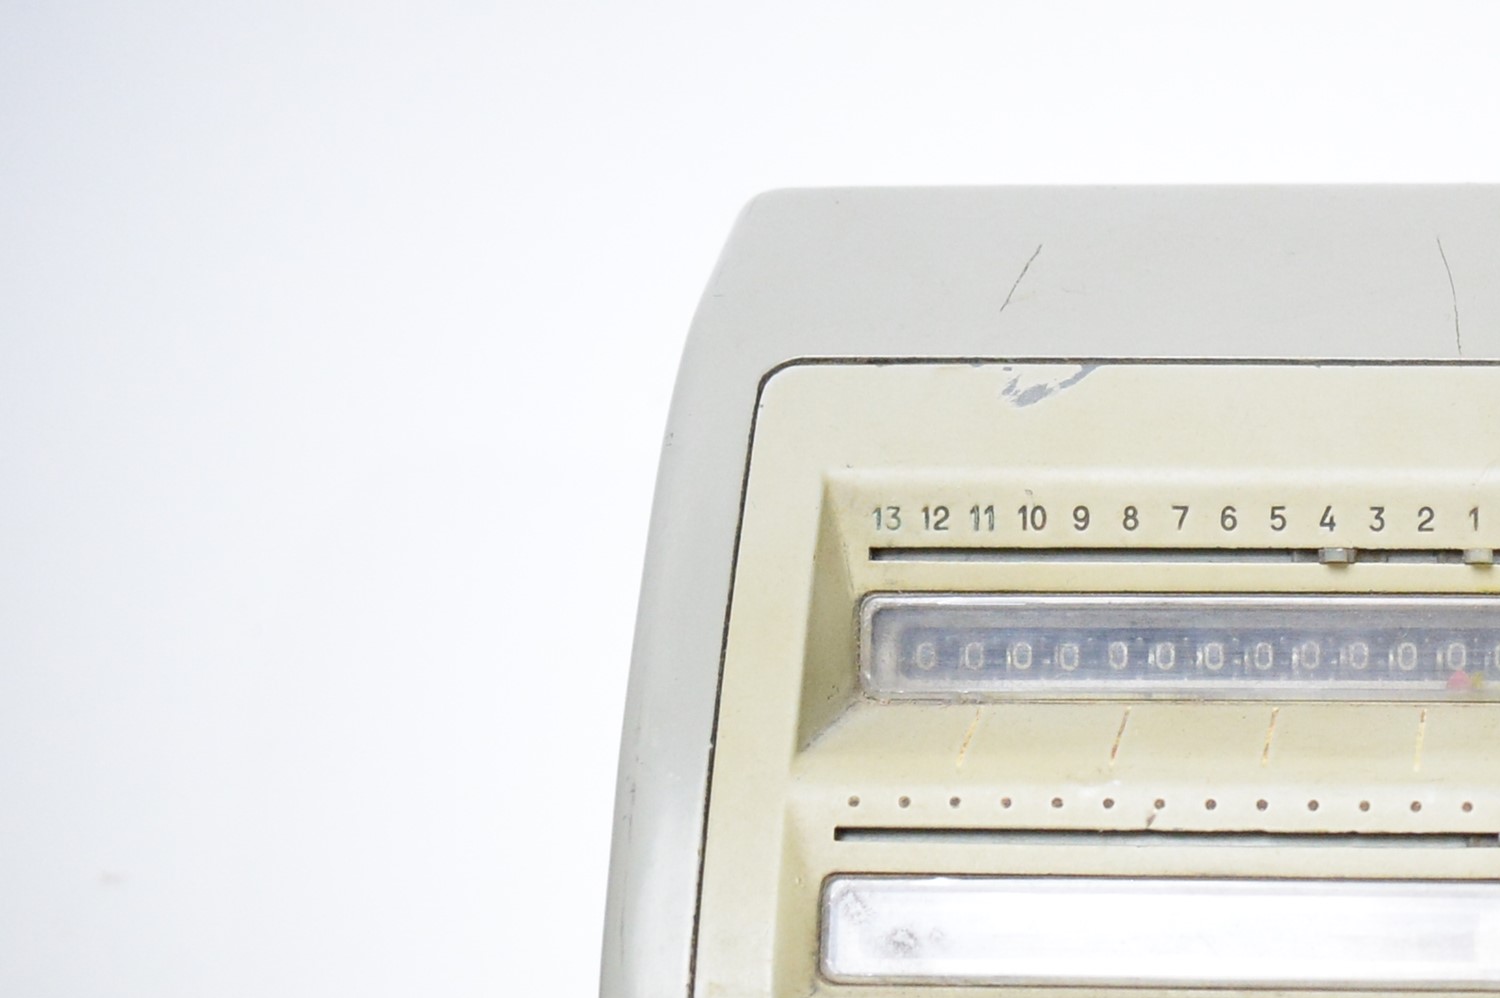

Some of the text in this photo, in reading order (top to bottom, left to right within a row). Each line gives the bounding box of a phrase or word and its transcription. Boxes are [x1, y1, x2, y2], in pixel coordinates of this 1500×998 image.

[872, 504, 1479, 532] 13 12 11 10 9 8 7 6 5 4 3 2 1
